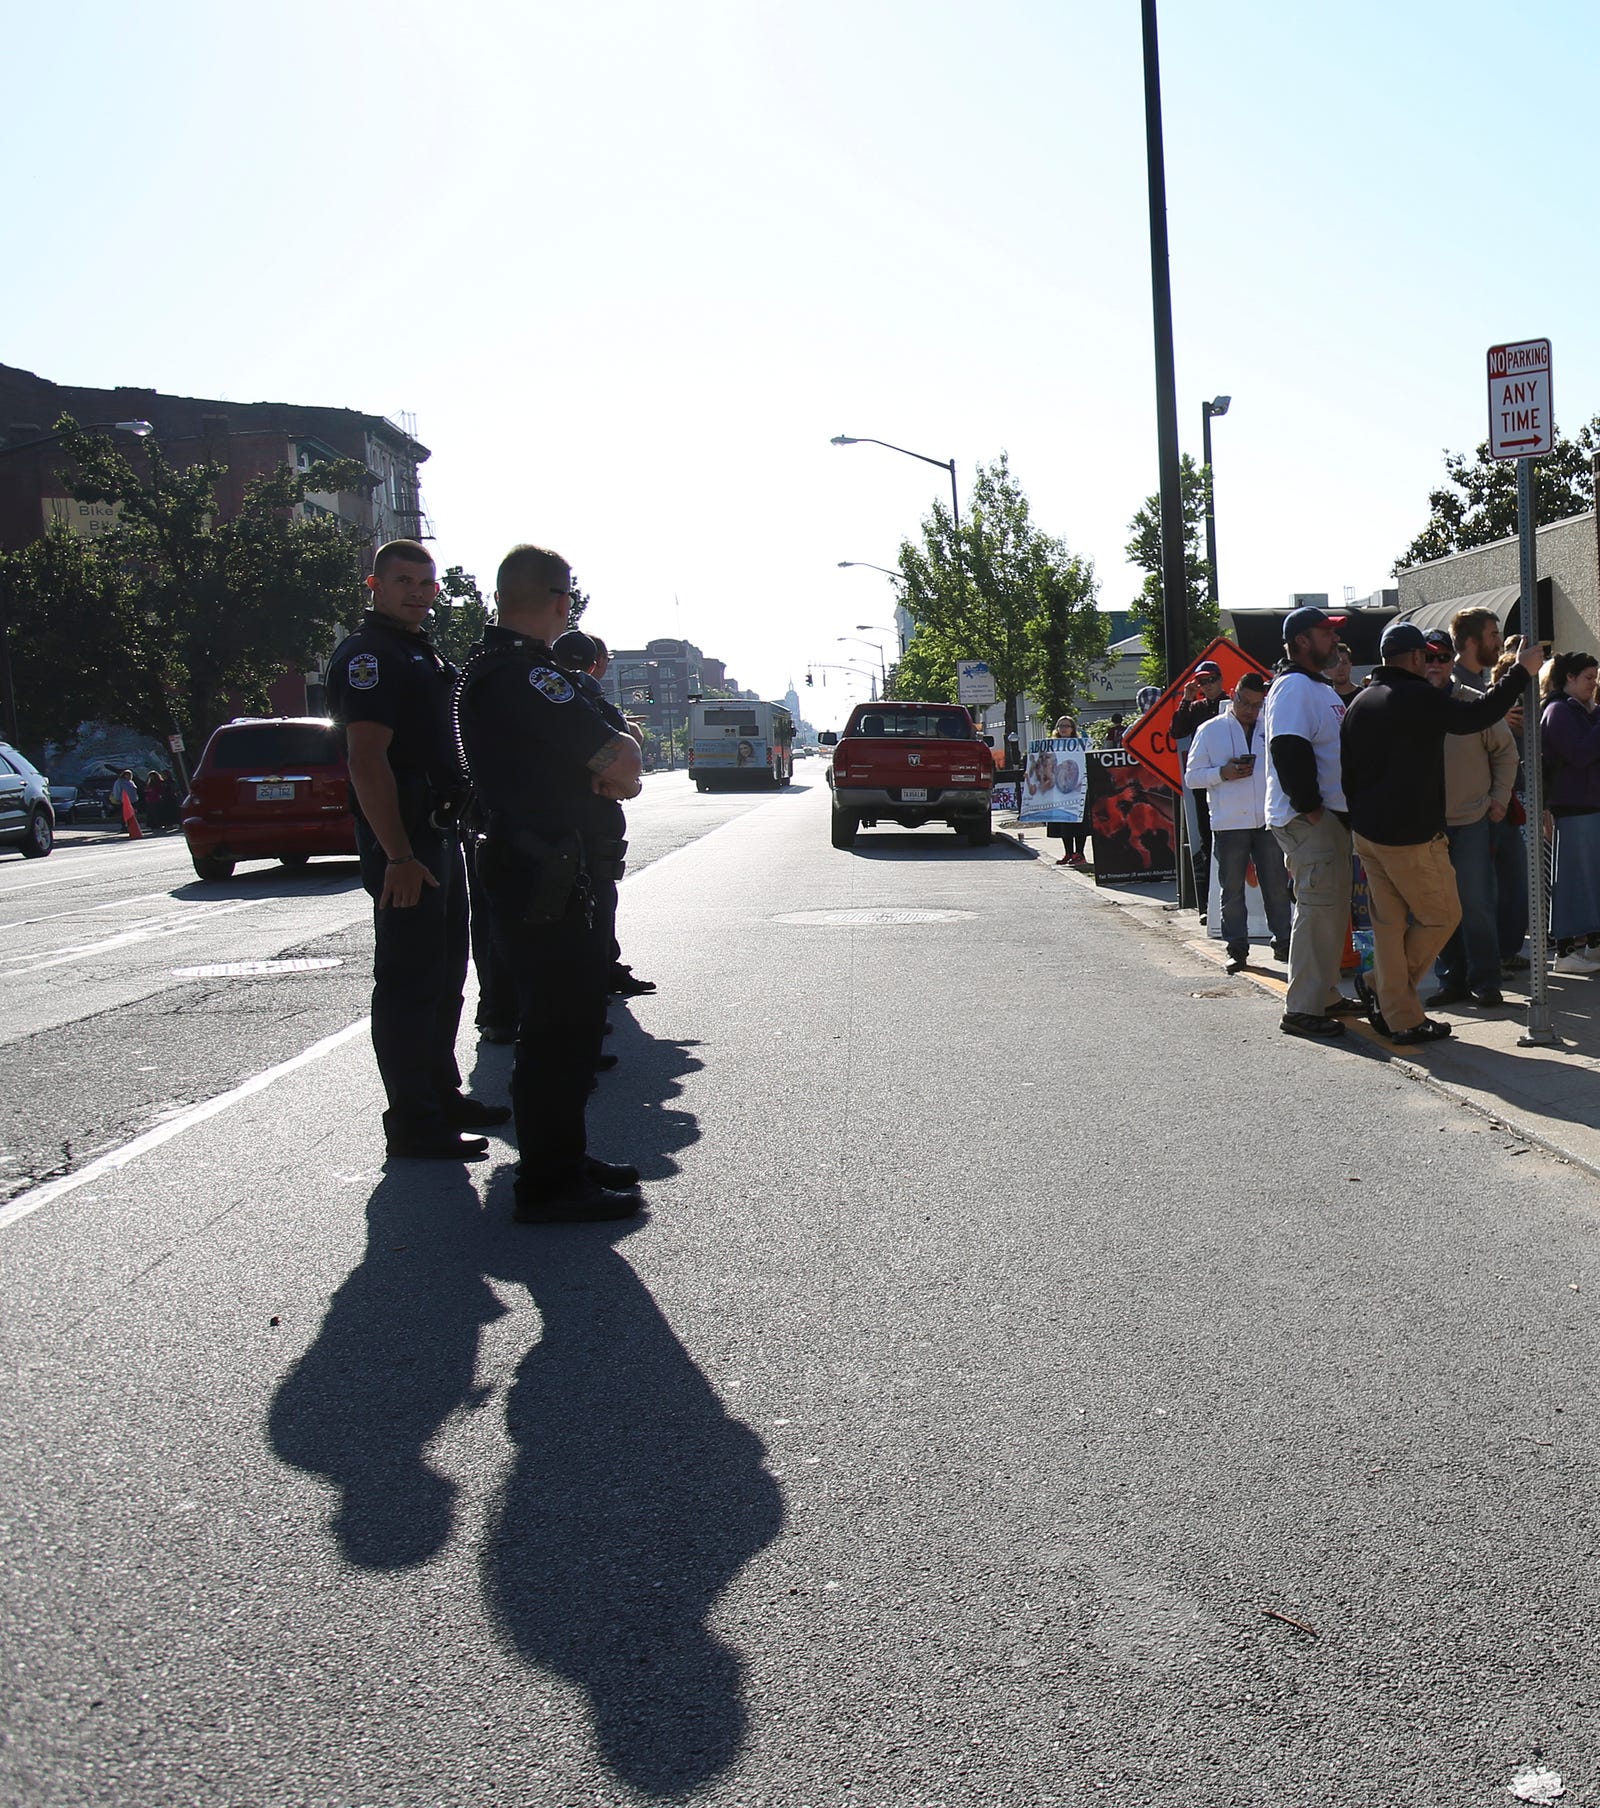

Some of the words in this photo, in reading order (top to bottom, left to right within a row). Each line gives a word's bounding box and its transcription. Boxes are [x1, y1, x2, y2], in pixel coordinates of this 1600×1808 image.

[1489, 351, 1505, 374] NO
[1507, 346, 1547, 370] PARKING
[1502, 380, 1537, 406] ANY
[1501, 407, 1540, 433] TIME
[79, 505, 113, 516] Bike
[1028, 738, 1087, 753] ABORTION
